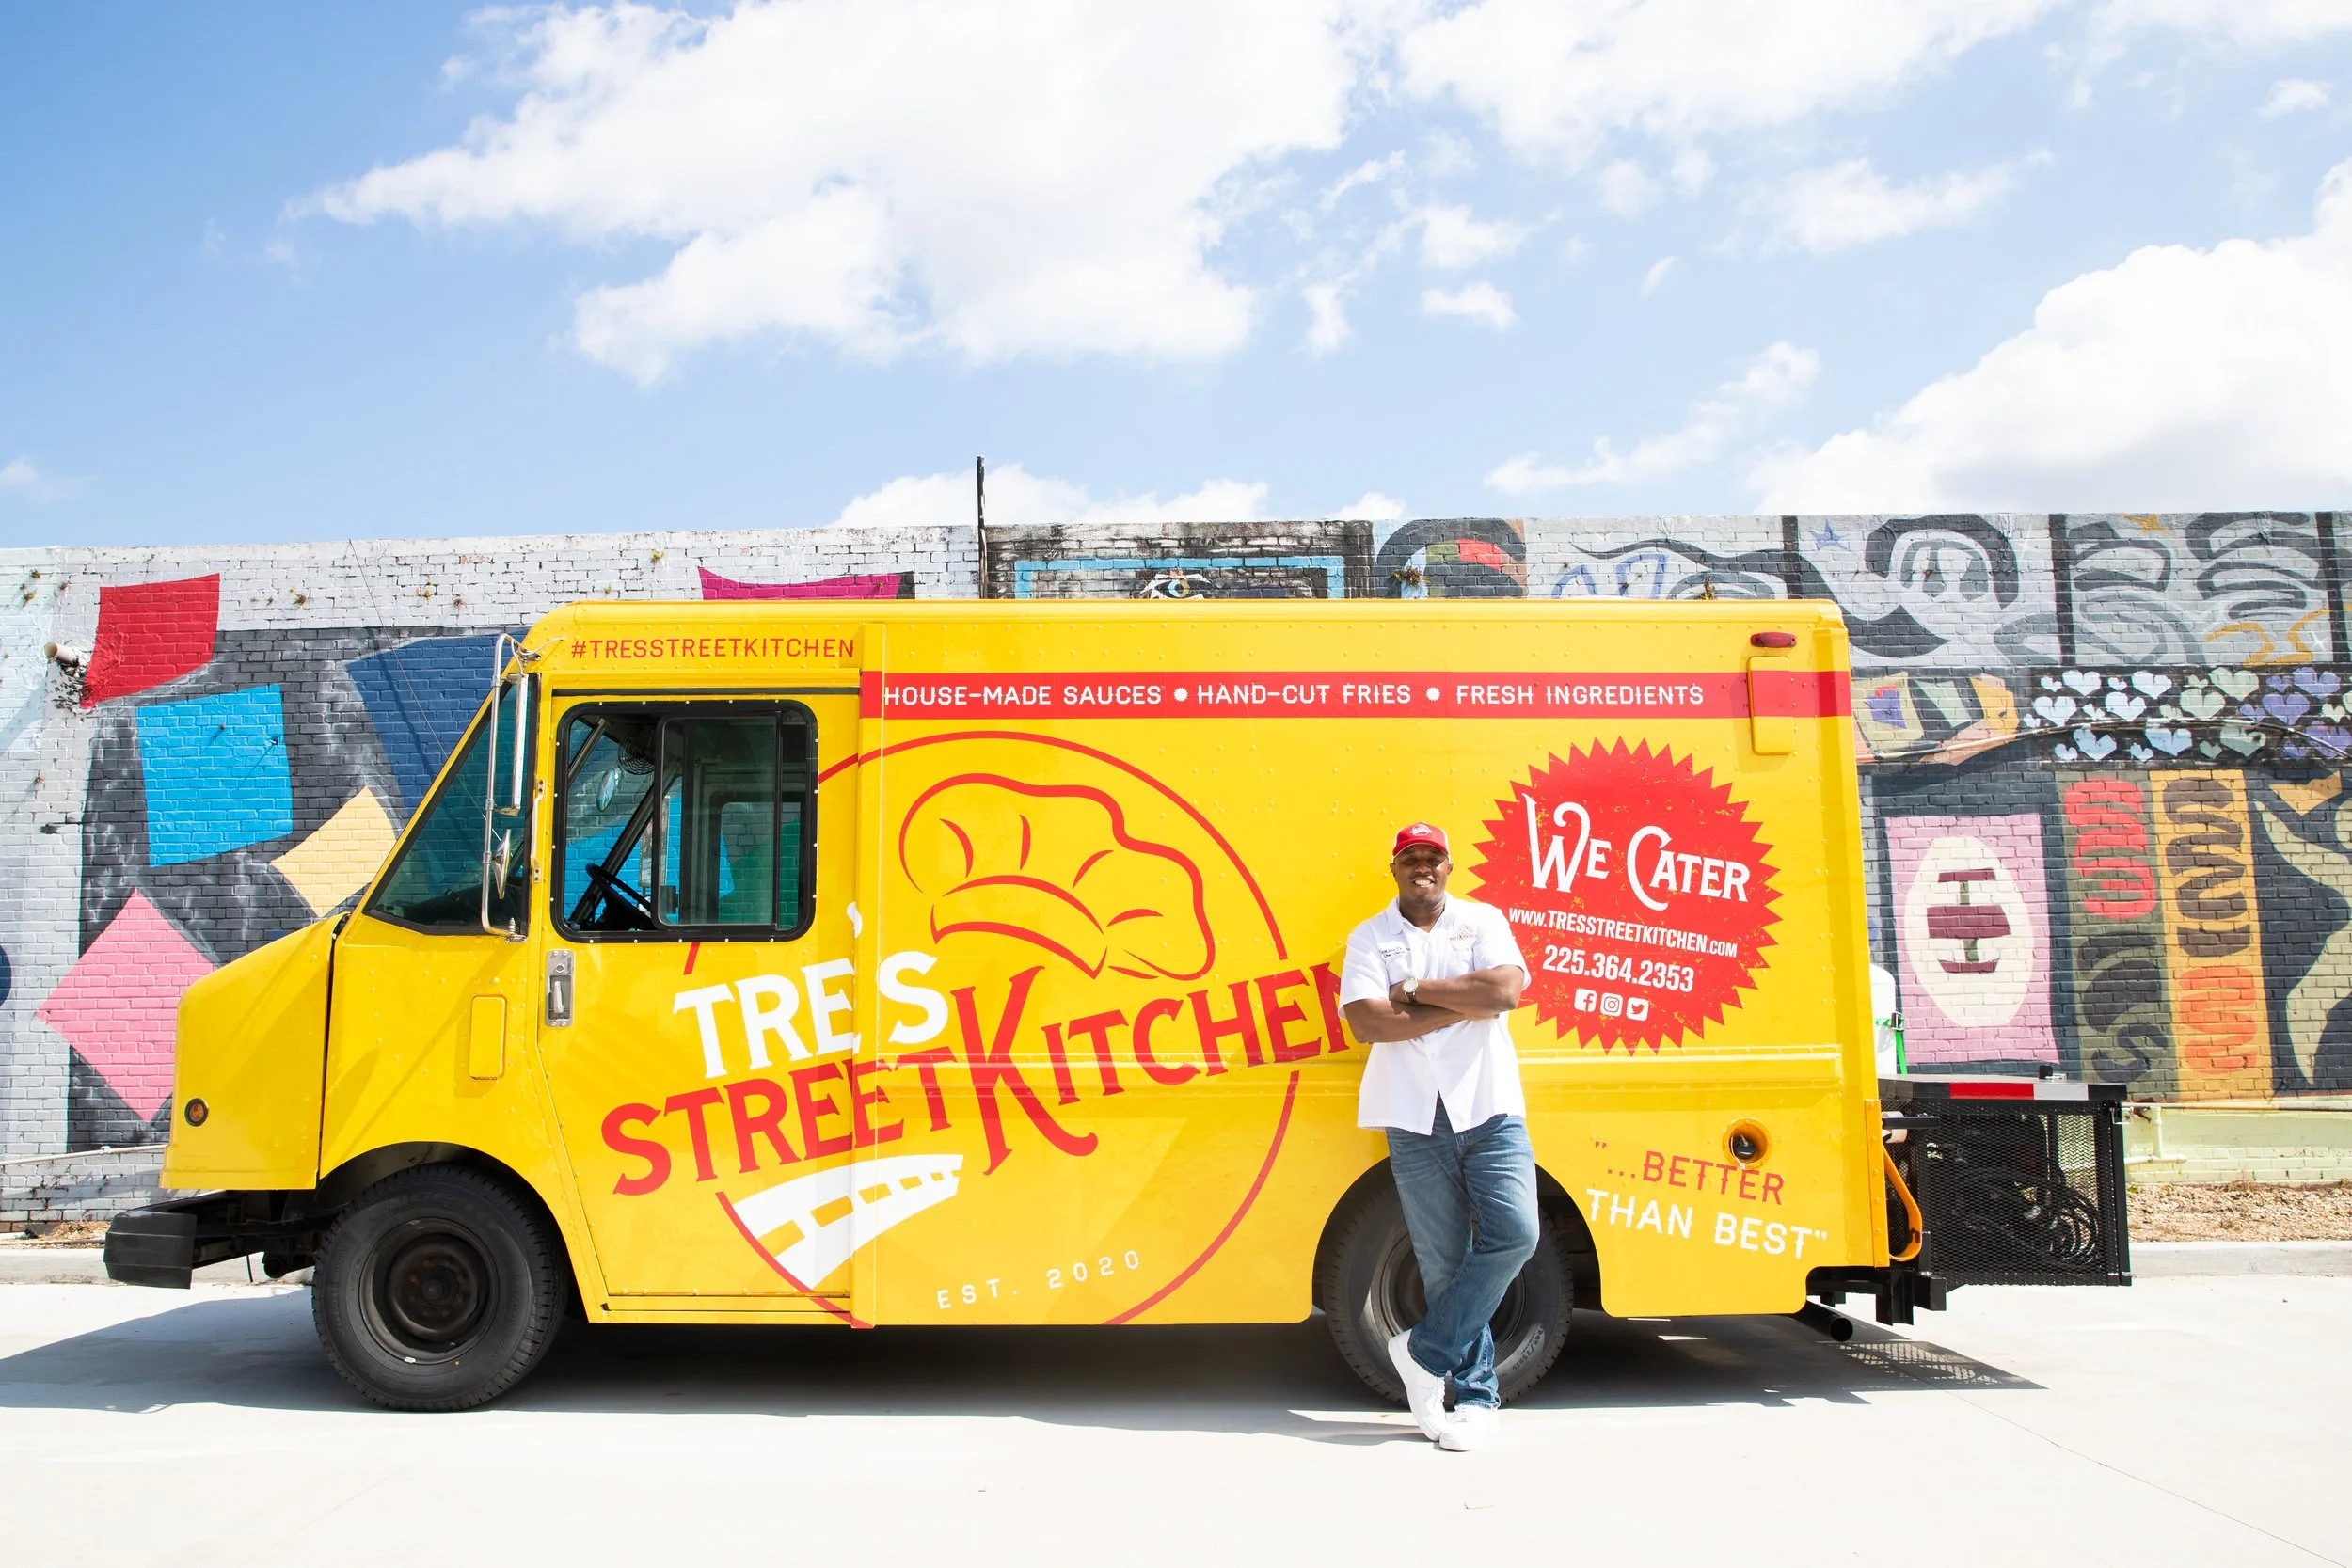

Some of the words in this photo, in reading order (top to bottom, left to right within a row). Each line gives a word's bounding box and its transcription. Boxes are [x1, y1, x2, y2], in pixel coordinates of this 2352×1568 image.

[570, 637, 855, 659] #TRESSTREETKITCHEN
[882, 685, 1053, 706] HOUSE-MADE
[1062, 684, 1162, 705] SAUCES
[1196, 683, 1331, 705] HAND-CUT
[1342, 683, 1412, 705] FRIES
[1455, 684, 1534, 705] FRESH
[1545, 684, 1706, 705] INGREDIENTS
[1542, 943, 1695, 993] 225.364.2353
[600, 1046, 953, 1196] STREET
[1585, 1187, 1694, 1240] THAN
[1712, 1211, 1829, 1260] BEST"
[935, 1277, 1018, 1310] EST.
[1044, 1249, 1140, 1291] 2020
